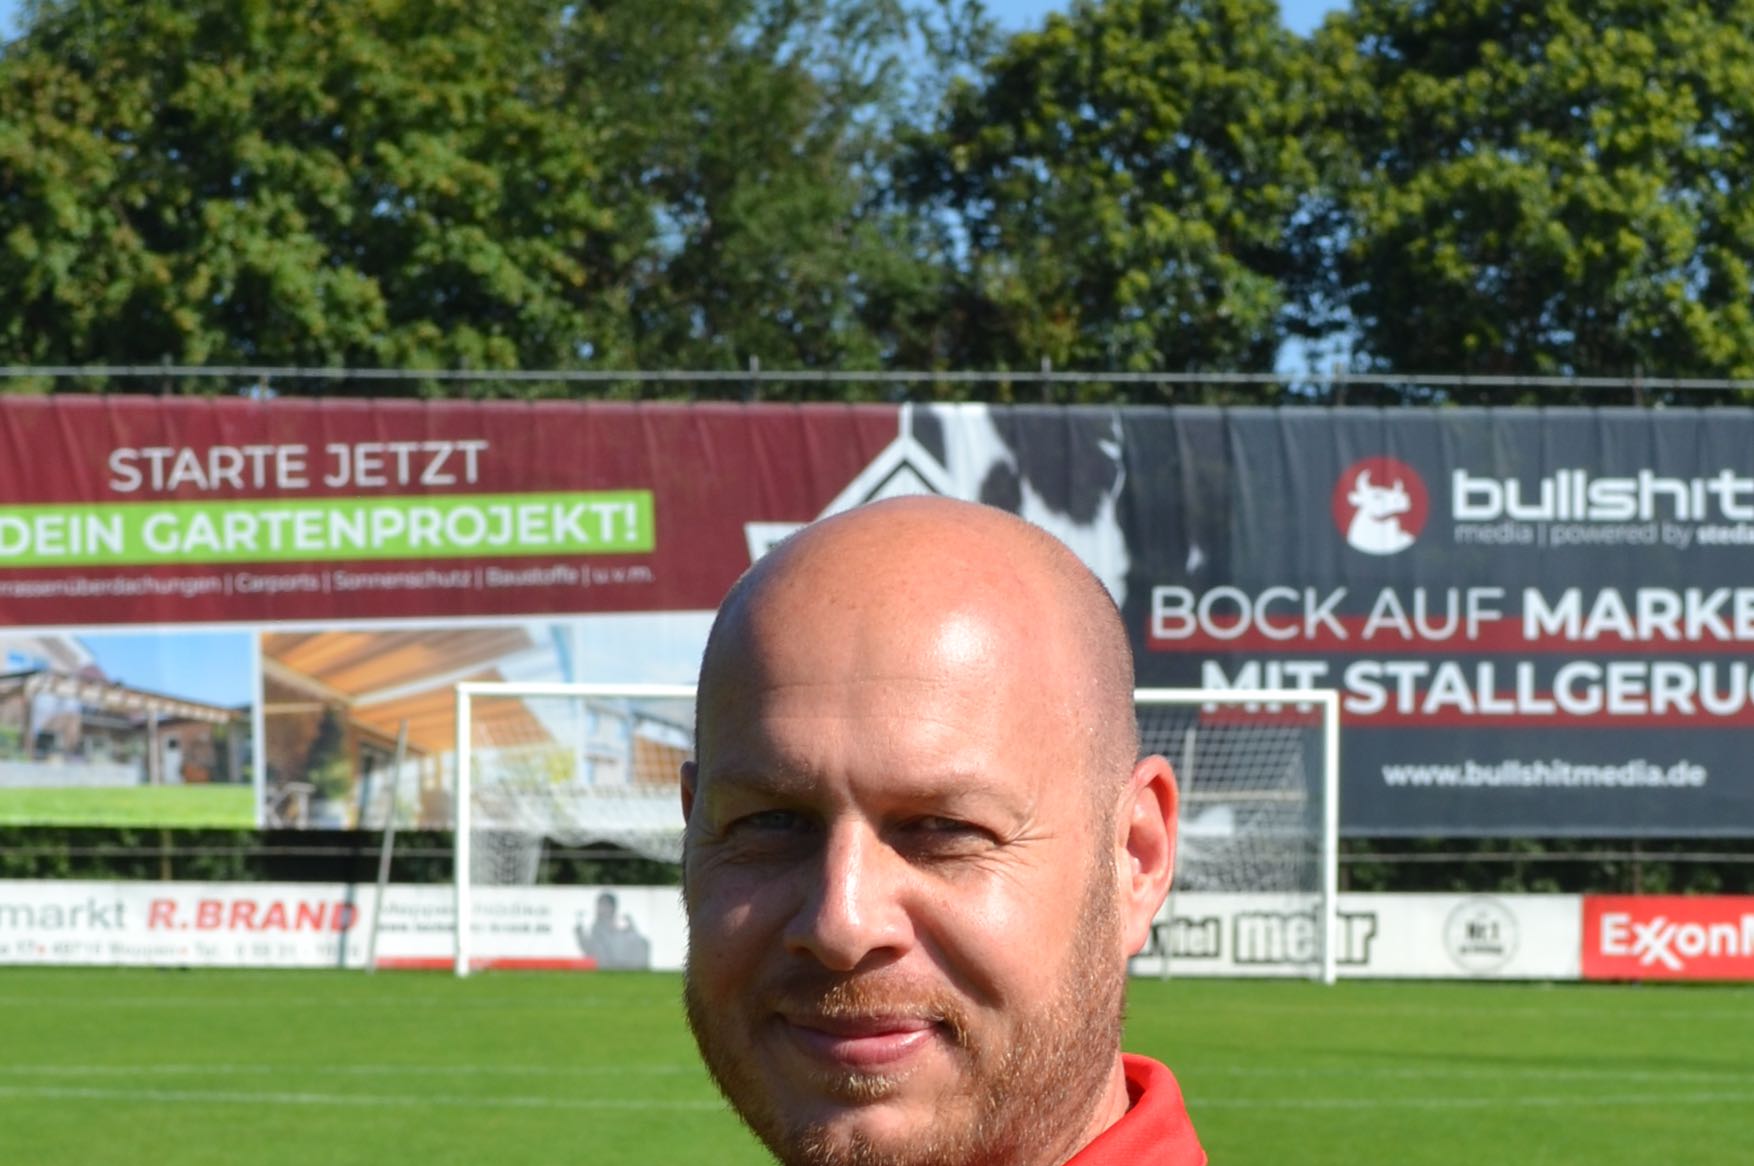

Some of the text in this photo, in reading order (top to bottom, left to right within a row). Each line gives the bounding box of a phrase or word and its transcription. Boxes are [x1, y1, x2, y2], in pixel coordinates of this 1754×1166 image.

[108, 439, 489, 492] STARTE JETZT
[1452, 468, 1754, 521] bullshit
[0, 500, 639, 555] DEIN GARTENPROJEKT!
[1454, 521, 1535, 545] media
[1550, 521, 1658, 549] powered
[1661, 520, 1694, 550] by
[1150, 586, 1754, 641] BOCK AUF MARKE
[1201, 660, 1754, 716] MIT STALLGERU
[1382, 758, 1708, 787] www.bullshitmedia.de
